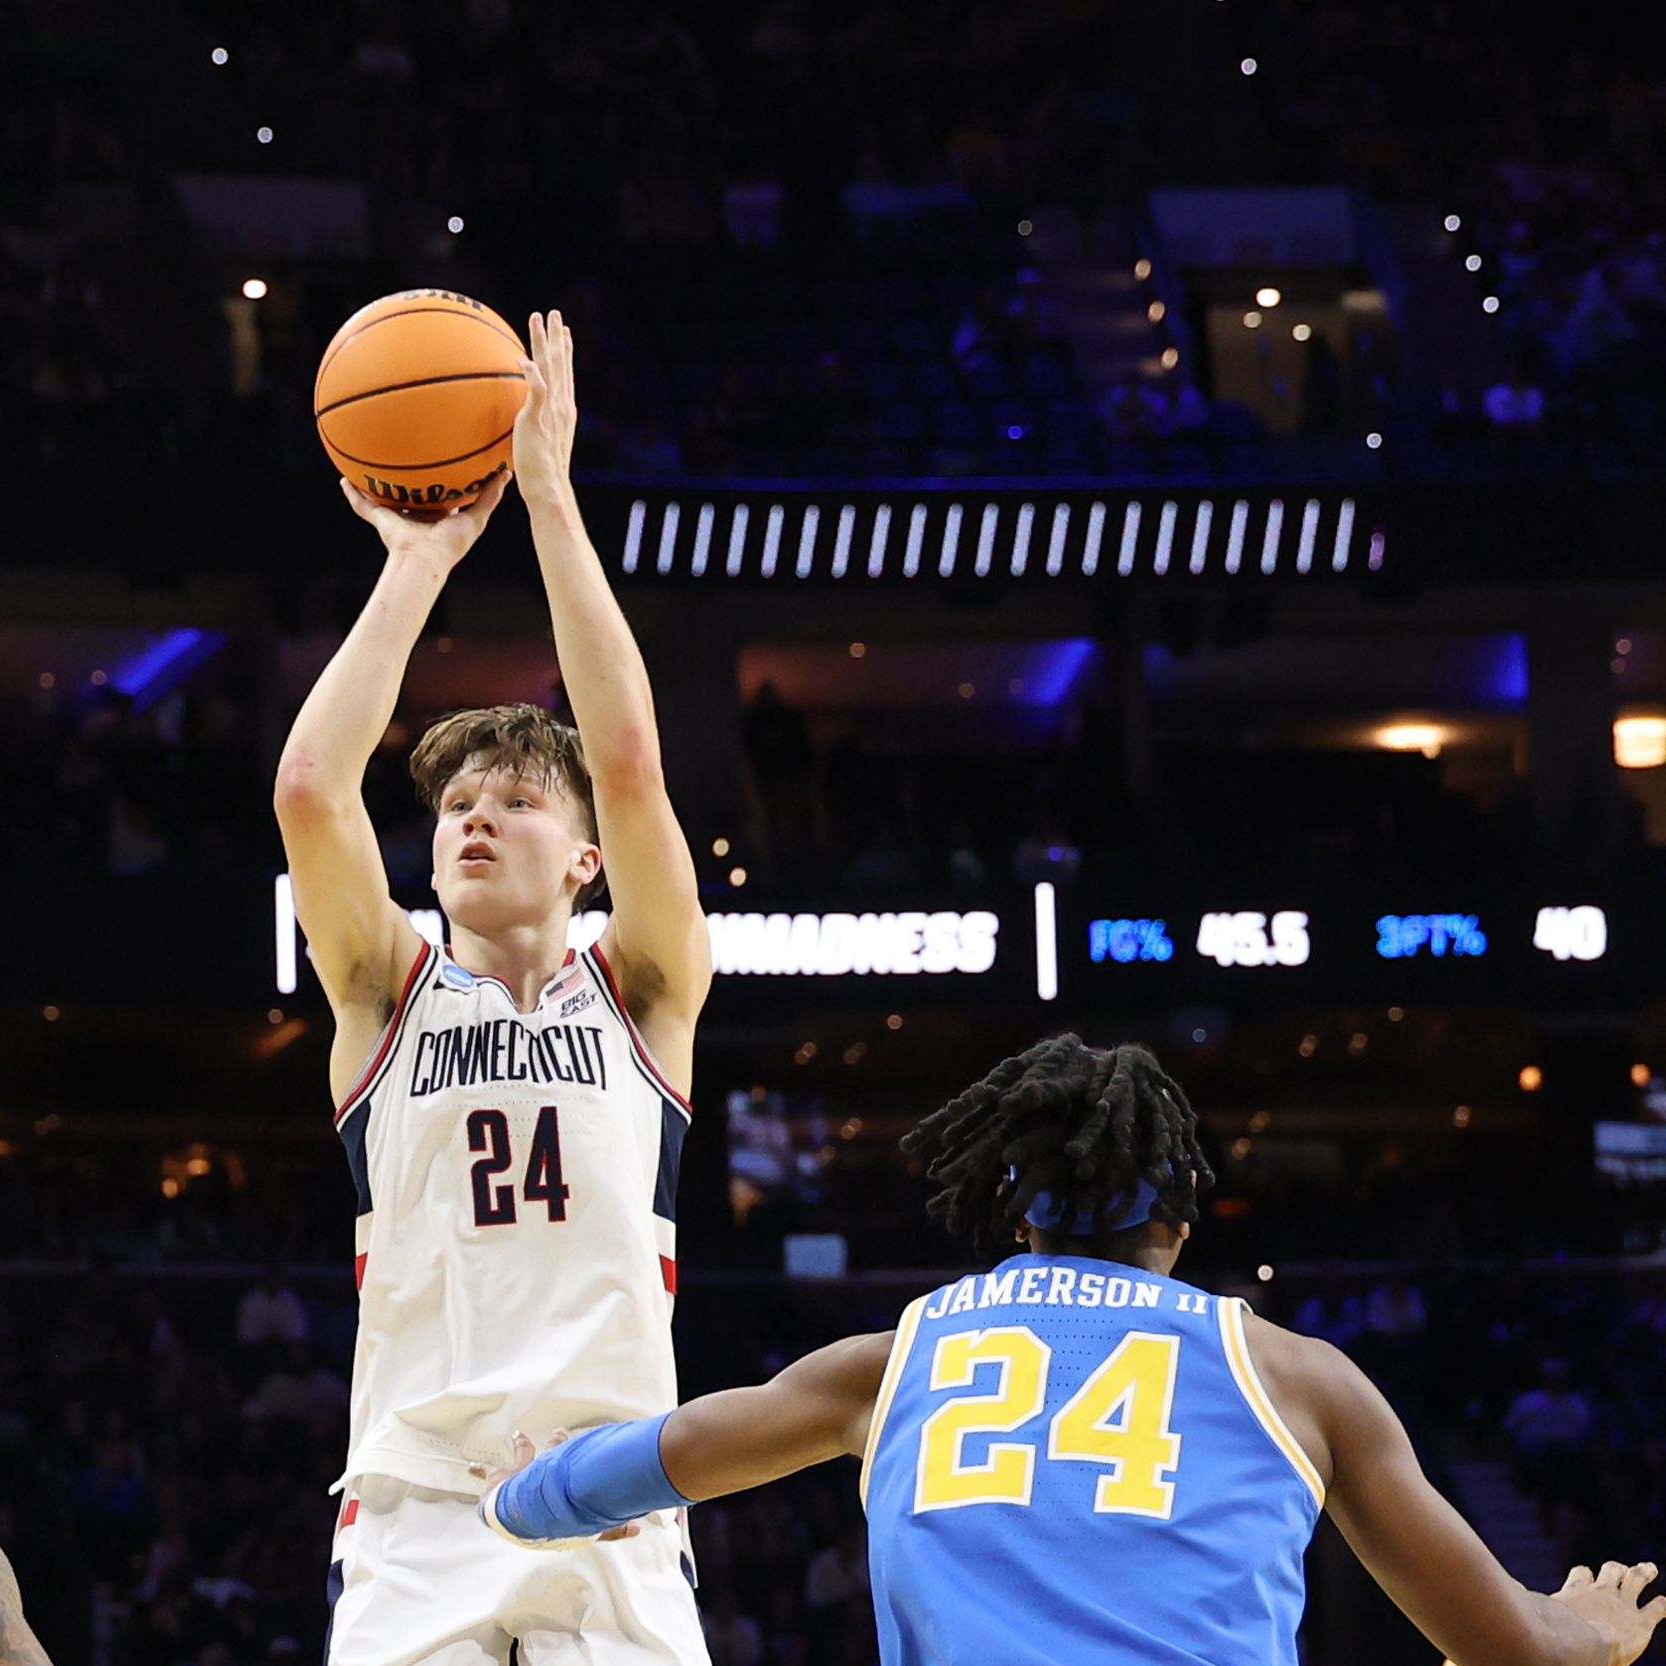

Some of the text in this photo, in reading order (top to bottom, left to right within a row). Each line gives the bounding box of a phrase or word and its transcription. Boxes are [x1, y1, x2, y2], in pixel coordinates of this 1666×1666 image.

[1533, 906, 1607, 960] 40
[410, 1019, 607, 1098] CONNECTICUT
[467, 1106, 569, 1226] 24
[925, 1266, 1207, 1320] JAMERSON II
[913, 1326, 1181, 1520] 24
